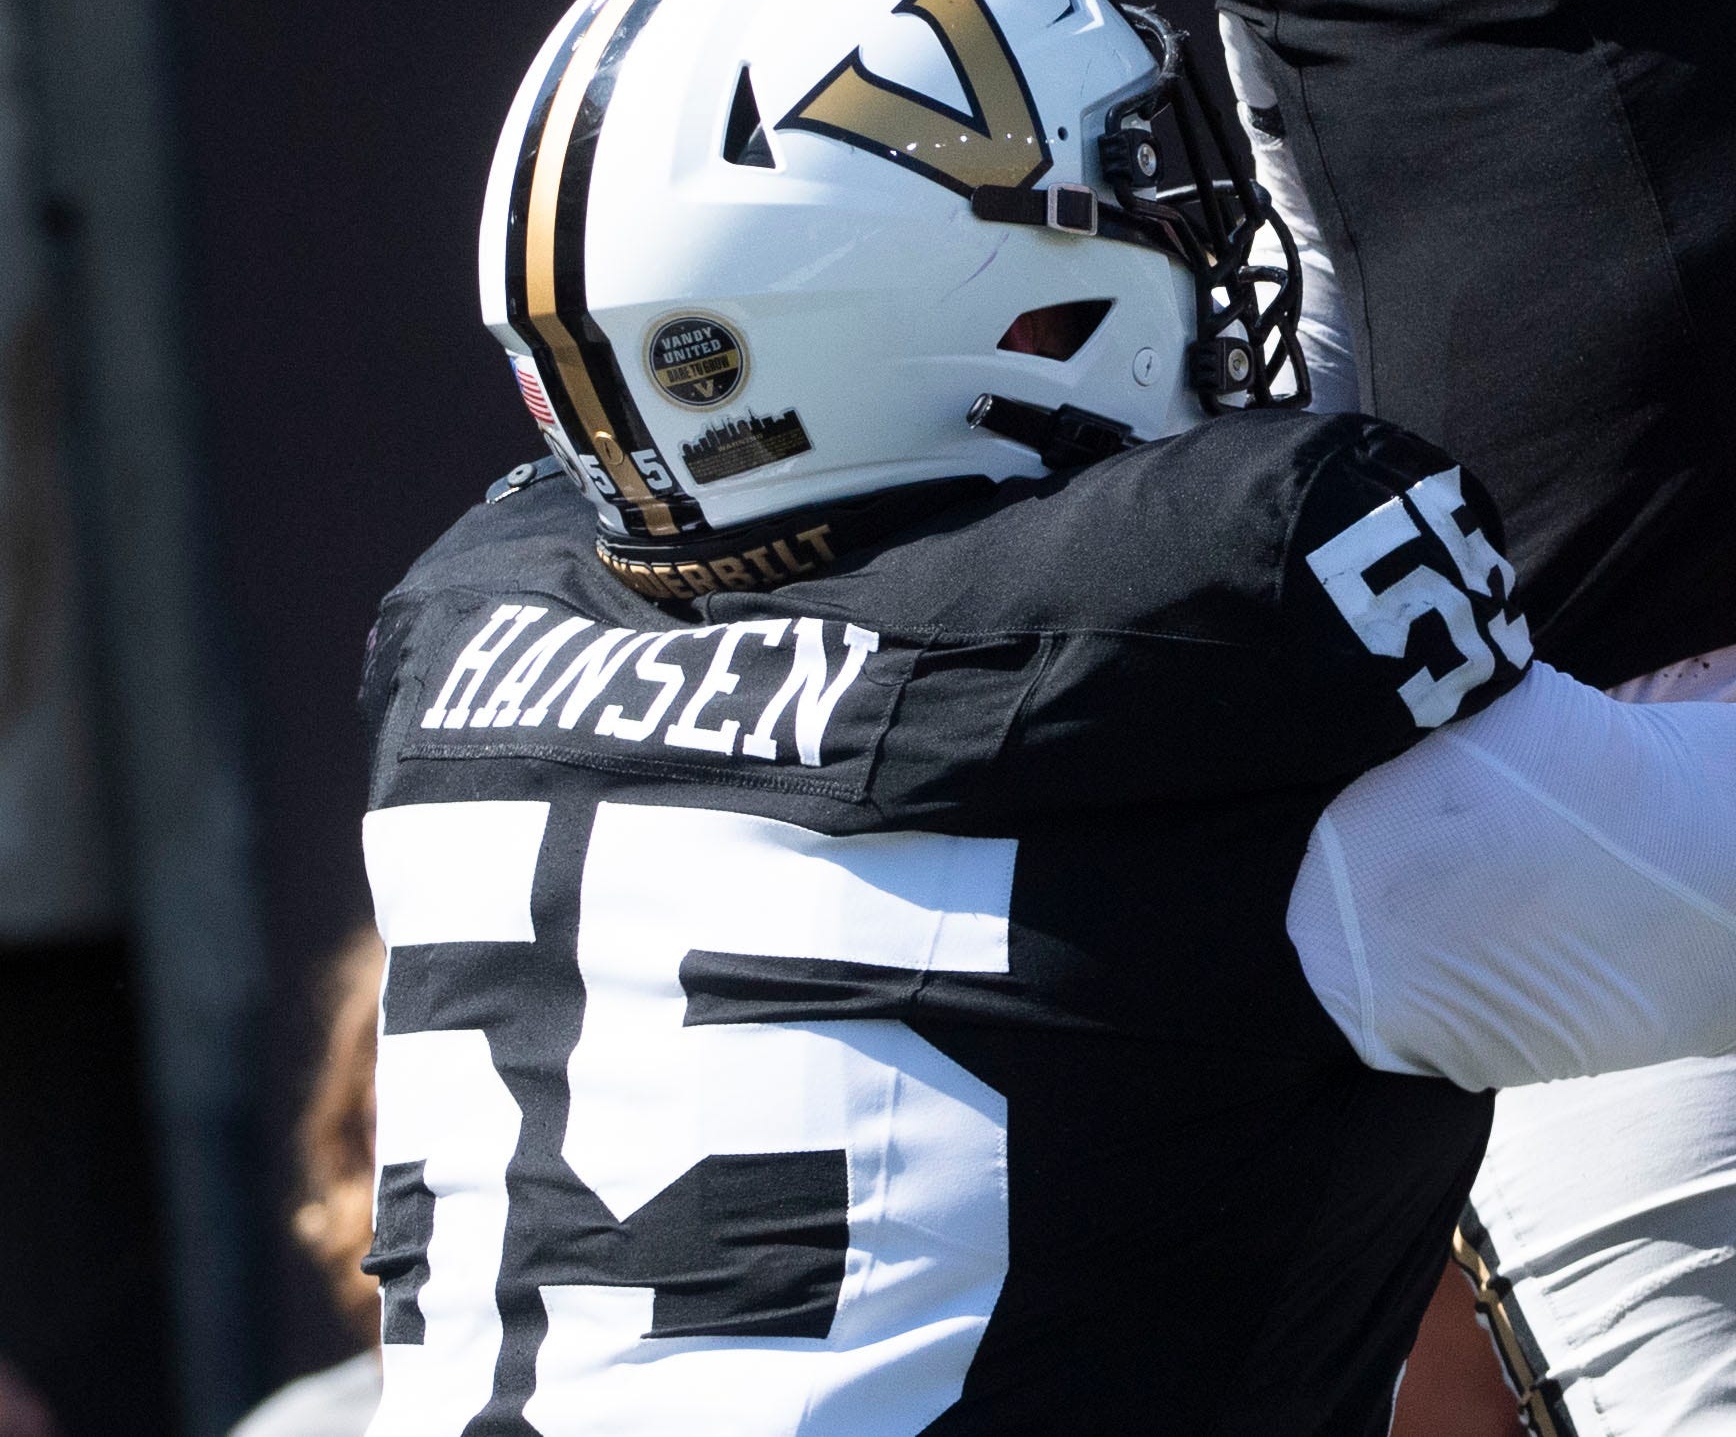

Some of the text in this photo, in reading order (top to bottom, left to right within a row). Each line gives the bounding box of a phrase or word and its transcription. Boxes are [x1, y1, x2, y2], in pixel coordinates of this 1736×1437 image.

[661, 326, 713, 350] VANDY
[663, 339, 722, 364] UNITED
[693, 379, 714, 398] V
[1305, 465, 1534, 728] 55
[421, 604, 879, 767] HANSEN
[362, 800, 1018, 1437] 55
